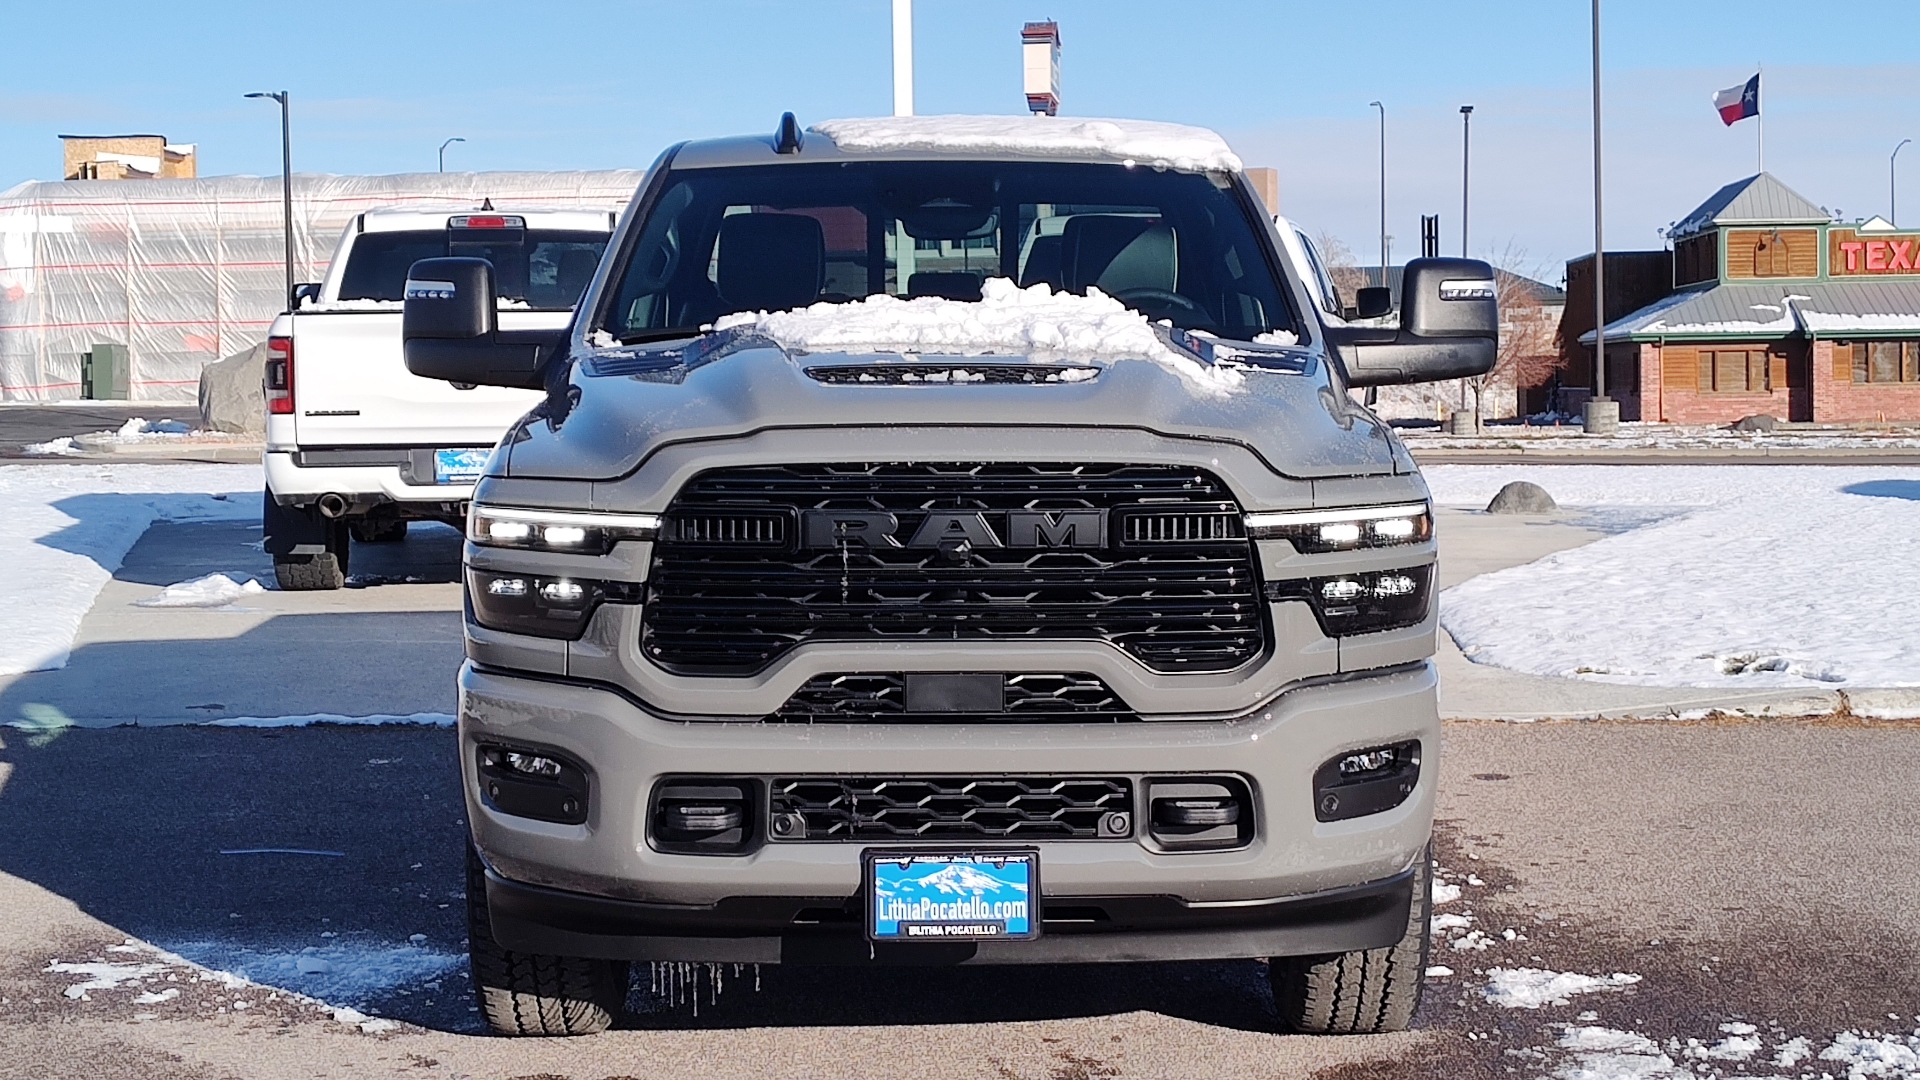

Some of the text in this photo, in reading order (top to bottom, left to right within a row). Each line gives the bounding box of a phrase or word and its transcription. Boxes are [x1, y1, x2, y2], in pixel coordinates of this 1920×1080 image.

[1840, 240, 1920, 271] TEX
[803, 509, 1107, 549] RAM
[879, 896, 1026, 921] LithiaPocatello.com
[945, 925, 996, 935] POCATELLO
